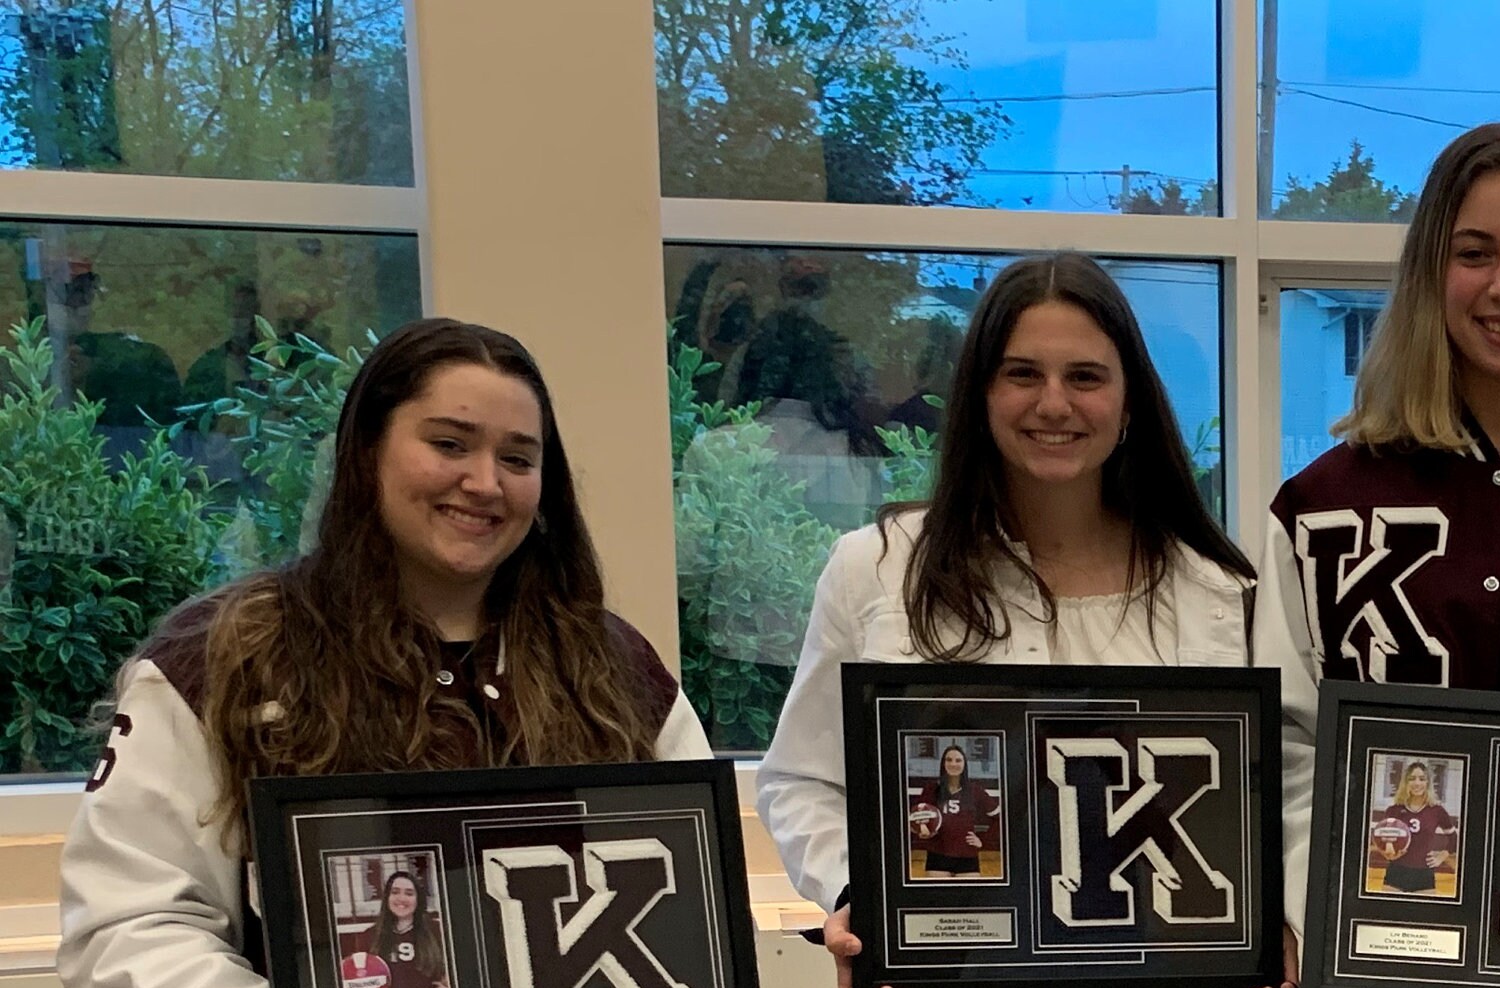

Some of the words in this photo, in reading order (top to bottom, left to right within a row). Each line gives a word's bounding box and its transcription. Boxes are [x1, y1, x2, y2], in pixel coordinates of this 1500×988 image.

[1296, 507, 1449, 689] K
[1046, 737, 1235, 927] K
[1409, 819, 1420, 833] 3
